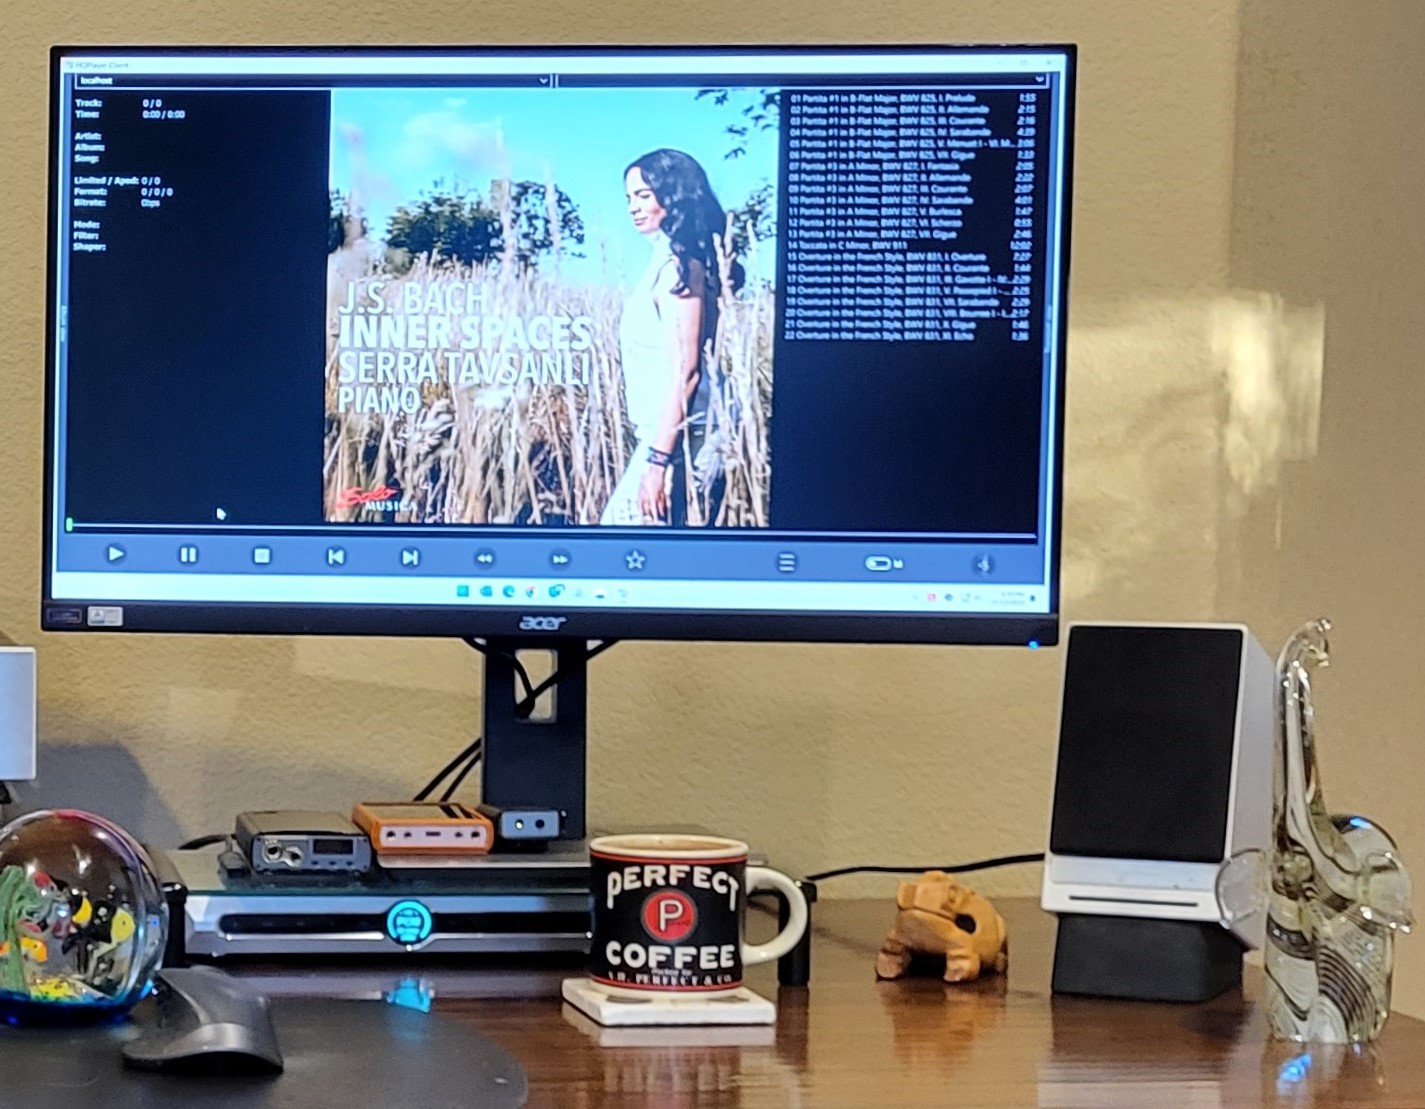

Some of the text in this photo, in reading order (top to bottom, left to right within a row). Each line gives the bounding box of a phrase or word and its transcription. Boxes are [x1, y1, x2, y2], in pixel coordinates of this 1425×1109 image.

[80, 76, 113, 85] localhost
[76, 99, 102, 107] Track:
[76, 110, 99, 118] Time:
[75, 132, 101, 140] Artist:
[75, 155, 99, 163] Song:
[74, 177, 106, 185] Limited
[74, 188, 107, 196] Format:
[74, 199, 106, 207] Bitrate:
[73, 221, 100, 229] Mode:
[73, 232, 99, 240] Filter:
[73, 243, 106, 252] Shaper:
[338, 282, 487, 314] J.S. BACH
[339, 315, 592, 350] INNER SPACES
[339, 351, 589, 385] SERRA TAVSANLI
[339, 387, 421, 414] PIANO
[365, 500, 417, 511] MUSICA
[519, 616, 567, 630] acer
[607, 864, 739, 912] PERFECT
[659, 899, 684, 932] P
[605, 940, 736, 970] COFFEE
